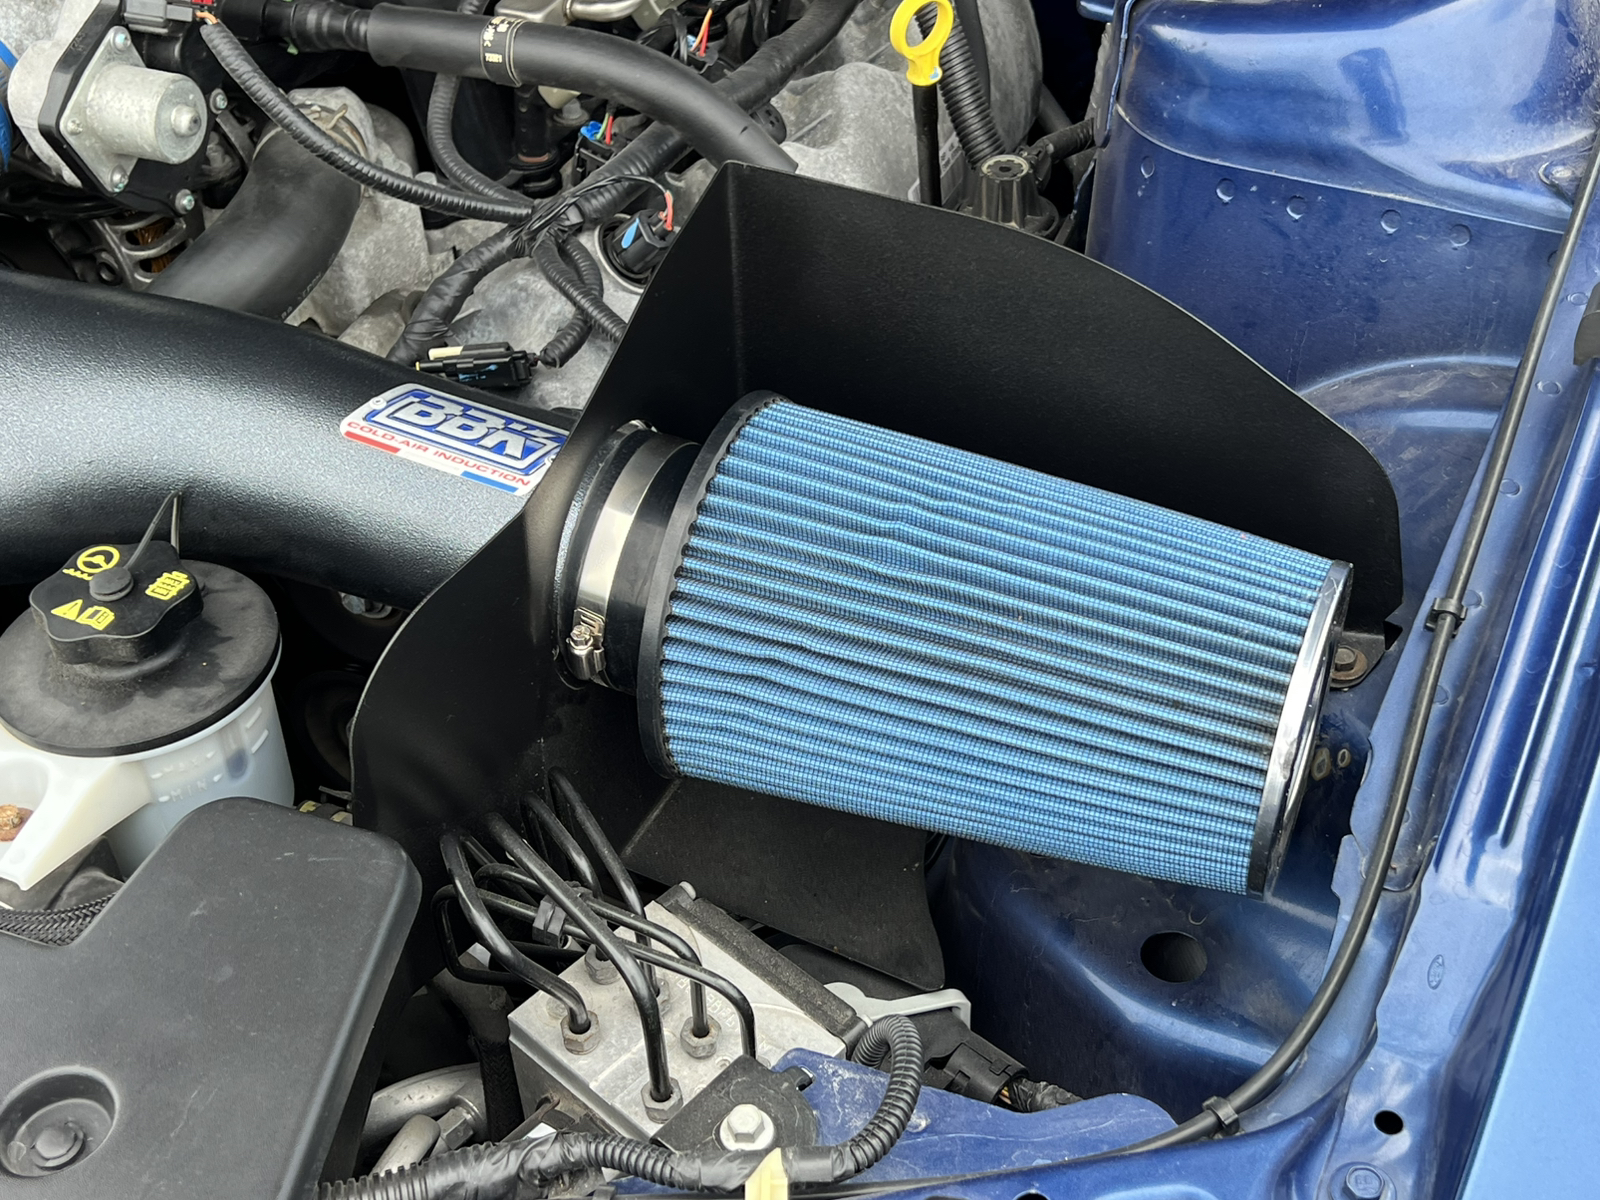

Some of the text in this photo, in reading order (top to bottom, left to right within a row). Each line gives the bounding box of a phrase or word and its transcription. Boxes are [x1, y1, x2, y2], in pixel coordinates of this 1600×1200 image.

[346, 420, 531, 487] COLD-AIR INDUCTION
[387, 395, 557, 461] BBK
[171, 778, 208, 802] MIN
